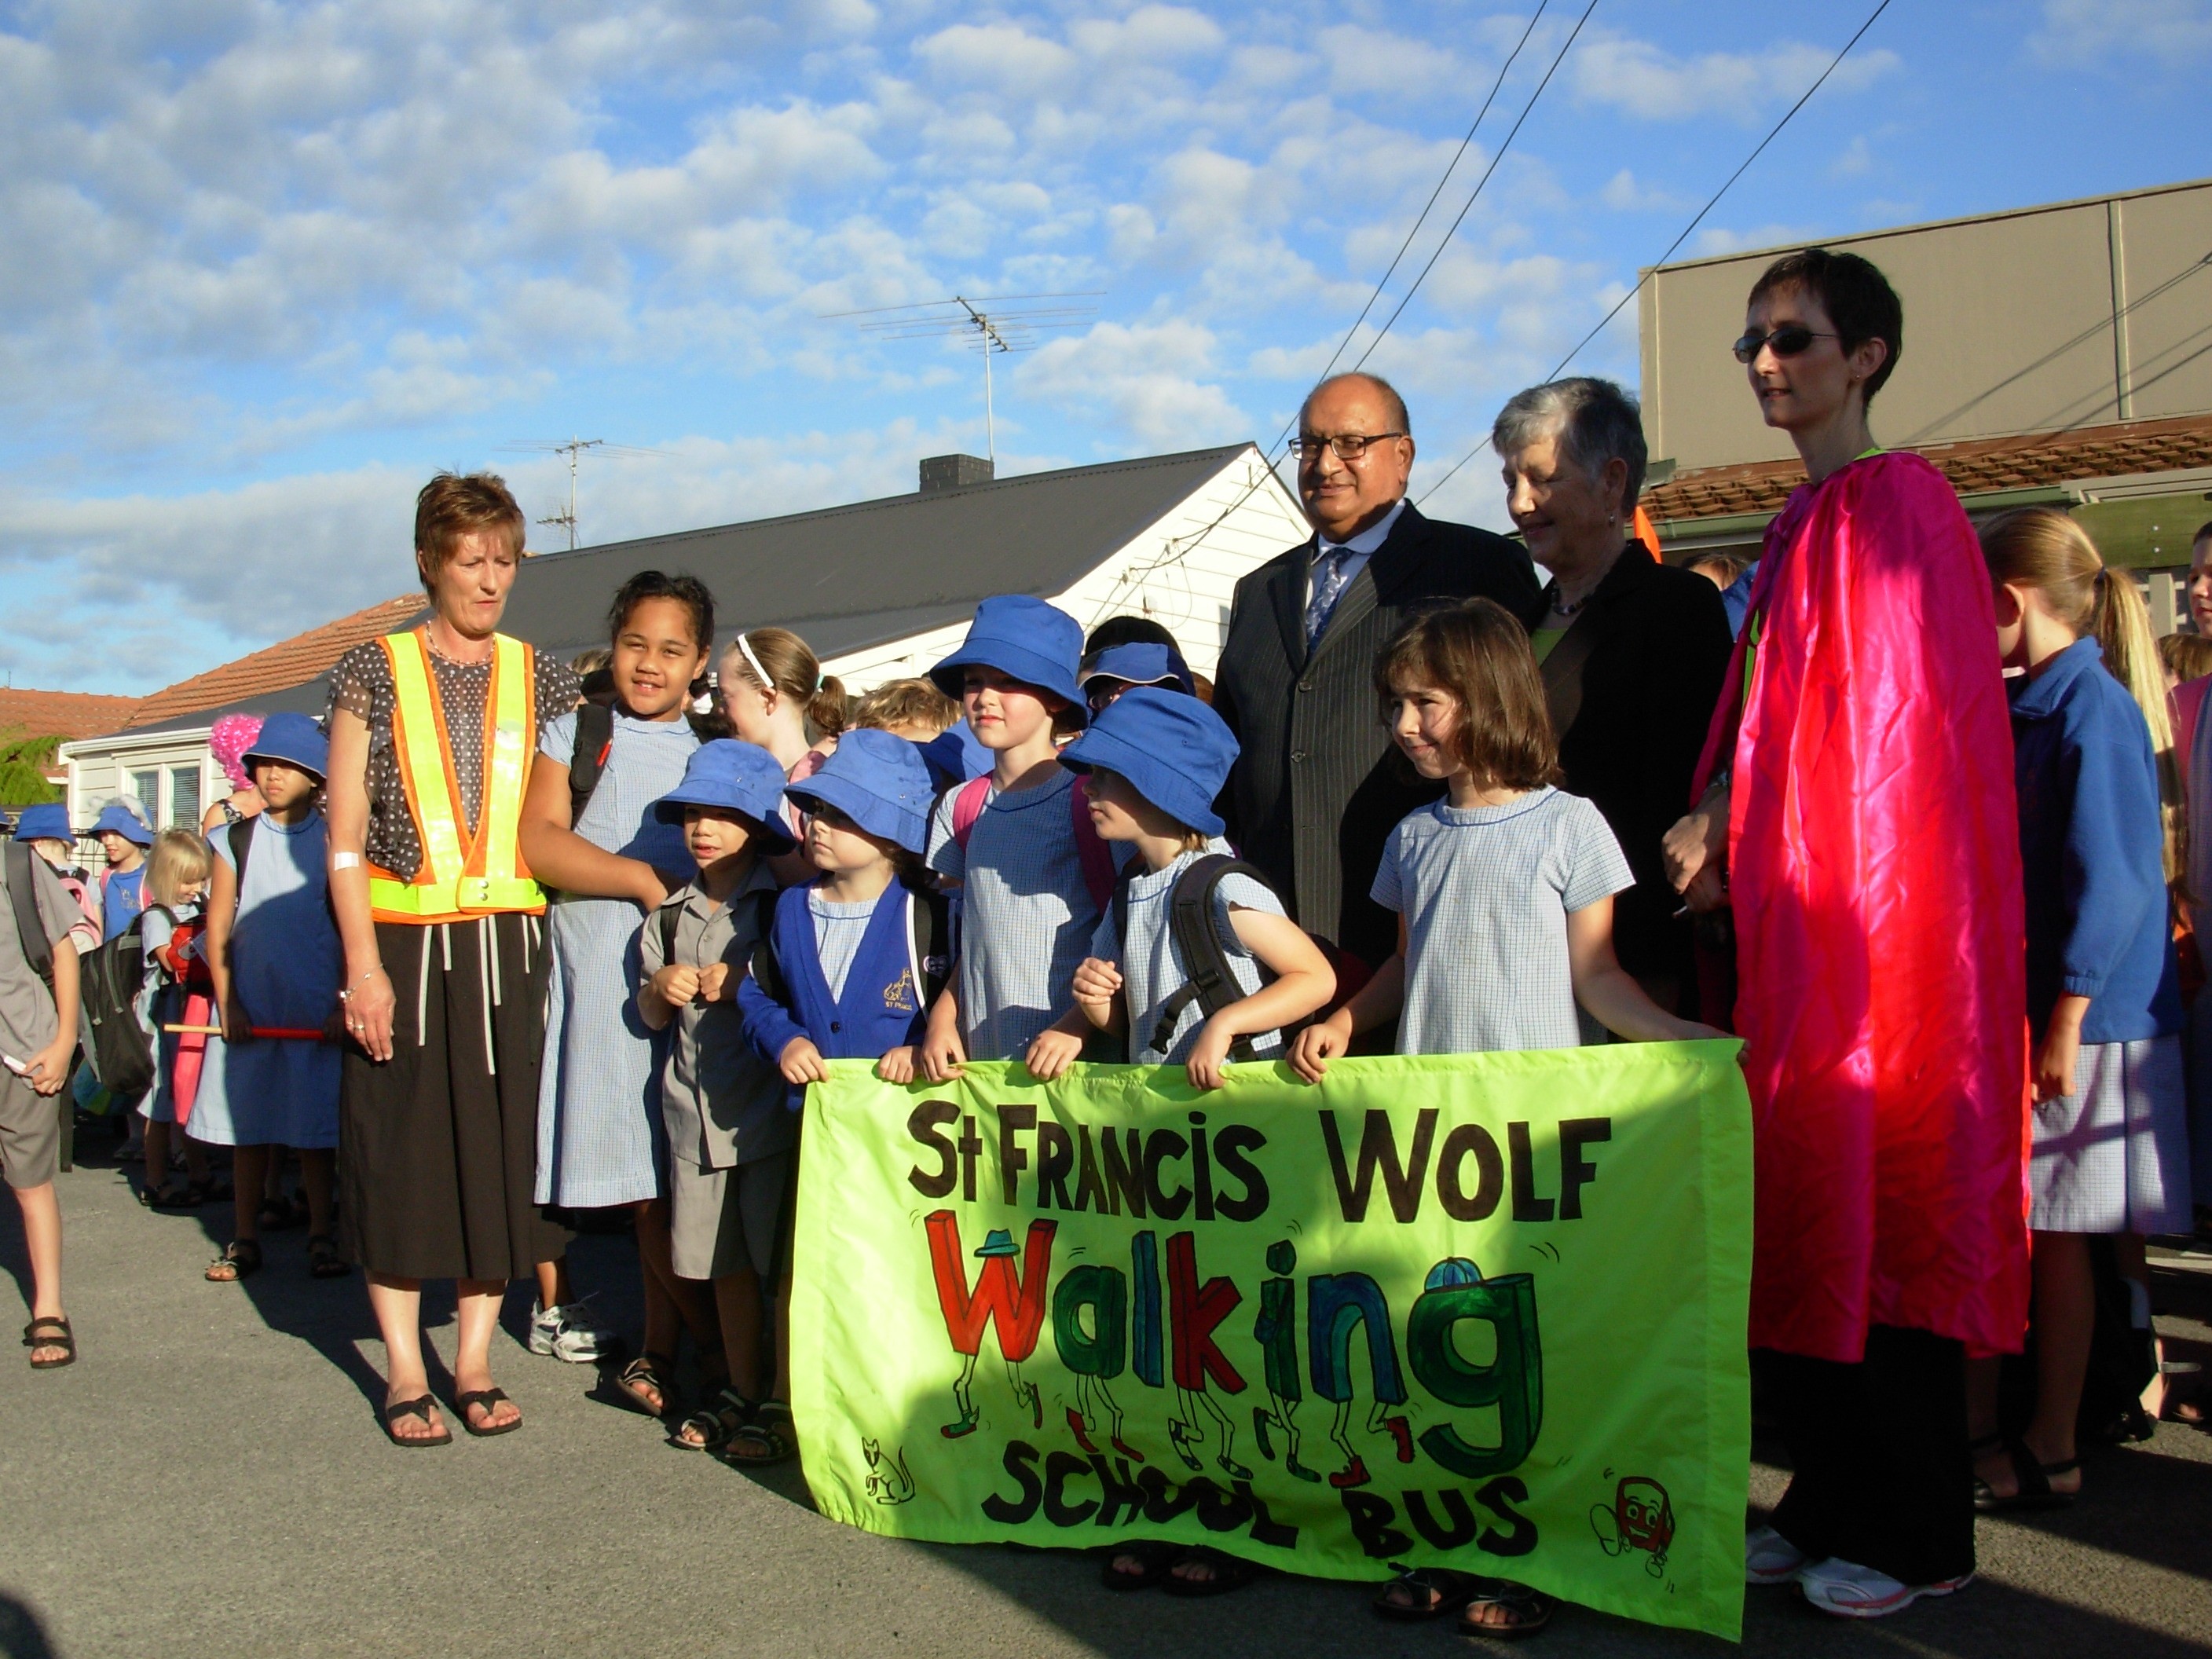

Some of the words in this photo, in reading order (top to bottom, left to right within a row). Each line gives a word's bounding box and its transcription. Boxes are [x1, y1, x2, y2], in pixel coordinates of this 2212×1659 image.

[907, 1100, 983, 1202] St
[1318, 1108, 1612, 1223] WOLF
[924, 1210, 1544, 1478] Walking
[981, 1440, 1298, 1549] SCHOOL
[1340, 1476, 1539, 1558] BUS
